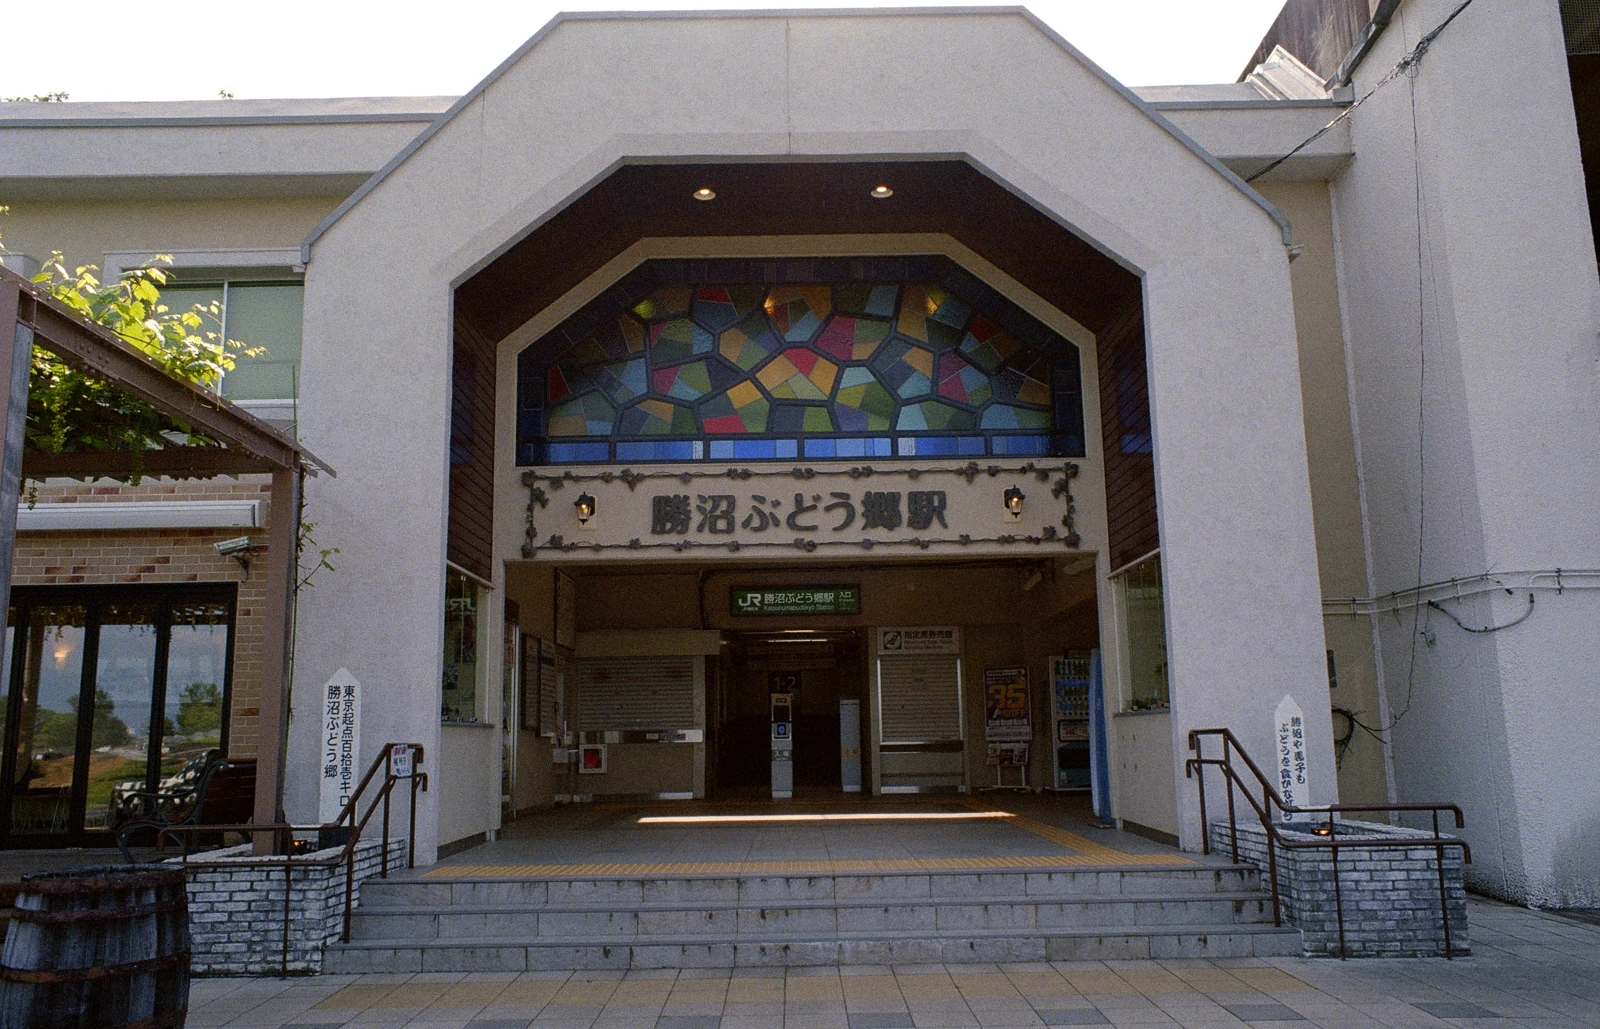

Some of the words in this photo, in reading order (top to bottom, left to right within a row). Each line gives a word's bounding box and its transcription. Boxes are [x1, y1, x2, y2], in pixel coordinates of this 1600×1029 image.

[650, 491, 948, 534] 勝沼ぶどう郷駅
[738, 593, 762, 606] JR
[764, 592, 834, 604] 勝沼ぶどう郷駅
[904, 630, 953, 643] 指定席券売機
[987, 683, 1027, 709] 35
[324, 685, 341, 779] 勝沼ぶどう郷
